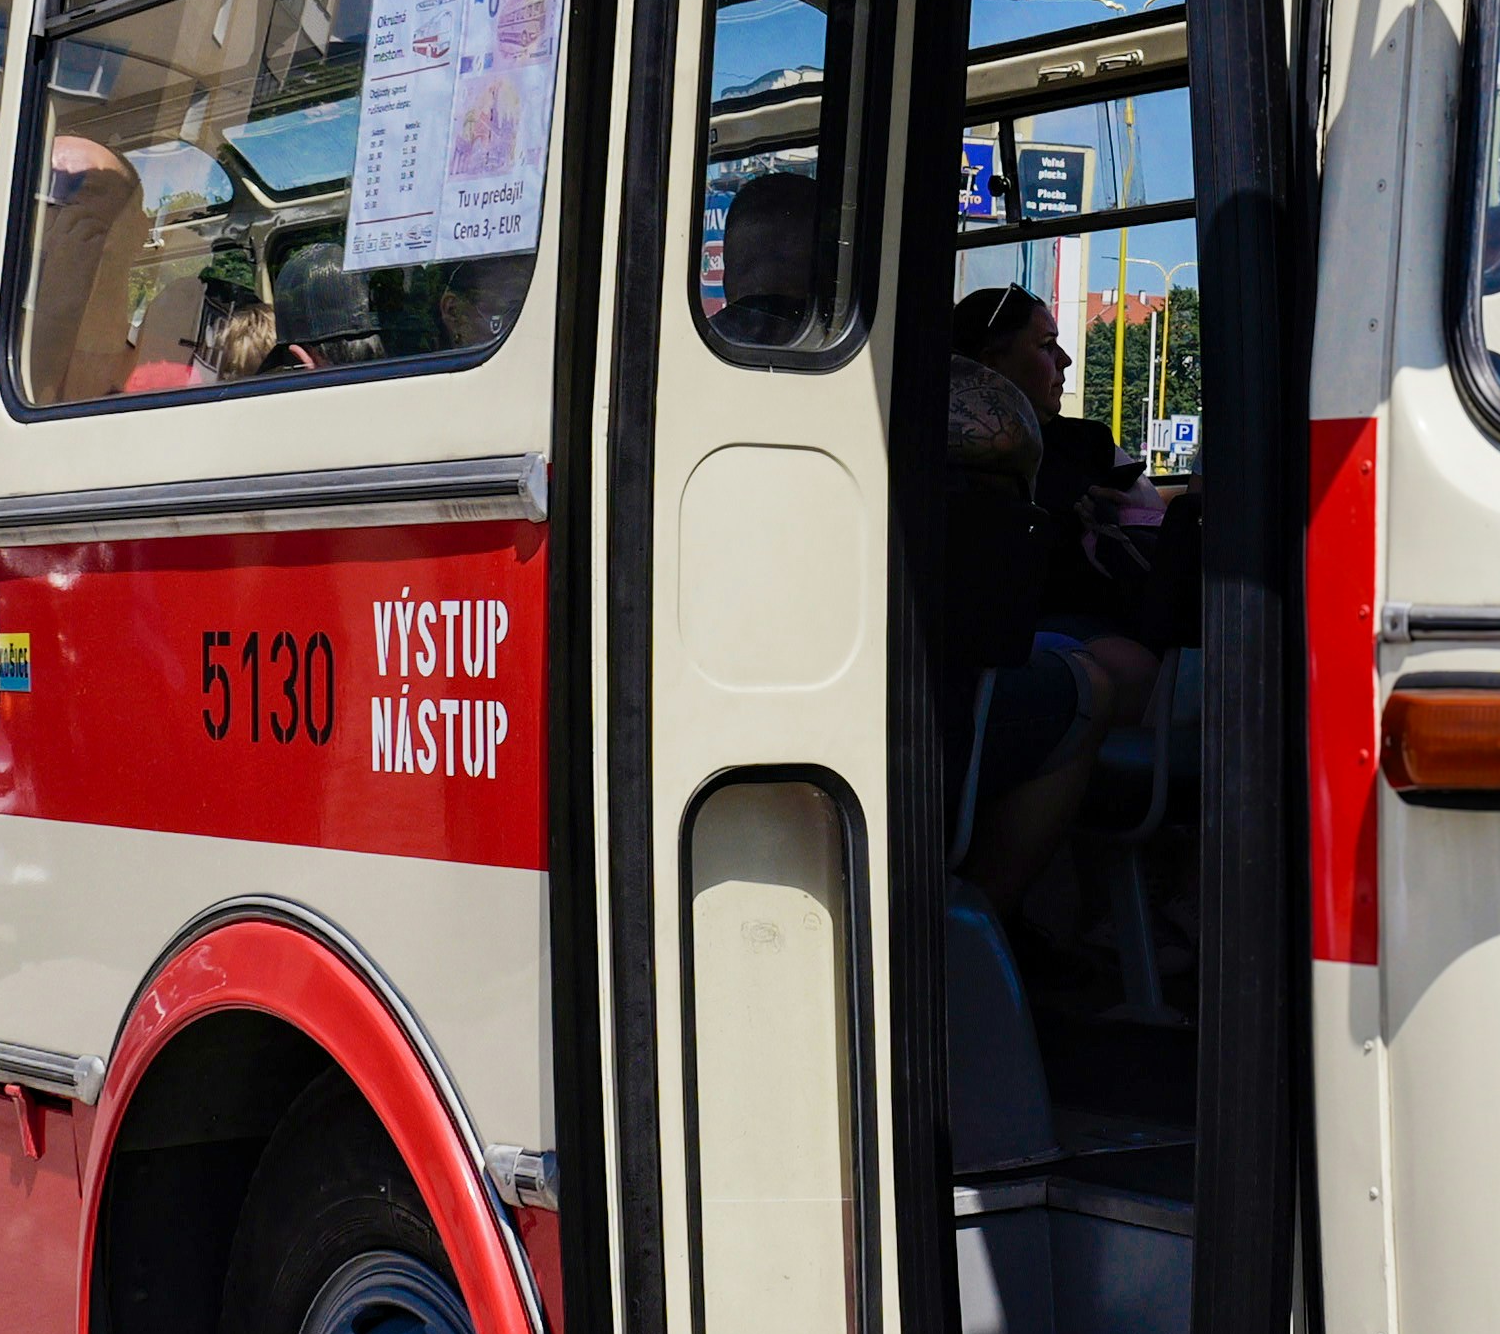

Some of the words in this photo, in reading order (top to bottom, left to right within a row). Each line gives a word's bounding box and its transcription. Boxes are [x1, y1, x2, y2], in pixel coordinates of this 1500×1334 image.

[374, 33, 394, 49] jazda
[458, 189, 470, 208] Tu
[472, 193, 479, 205] v
[481, 181, 523, 209] predaji!
[1038, 189, 1066, 199] Plocha
[454, 223, 480, 240] Cena
[482, 219, 496, 240] 3,-
[499, 215, 521, 235] EUR
[373, 586, 509, 679] VÝSTUP
[202, 631, 335, 746] 5130
[371, 683, 509, 779] NÁSTUP
